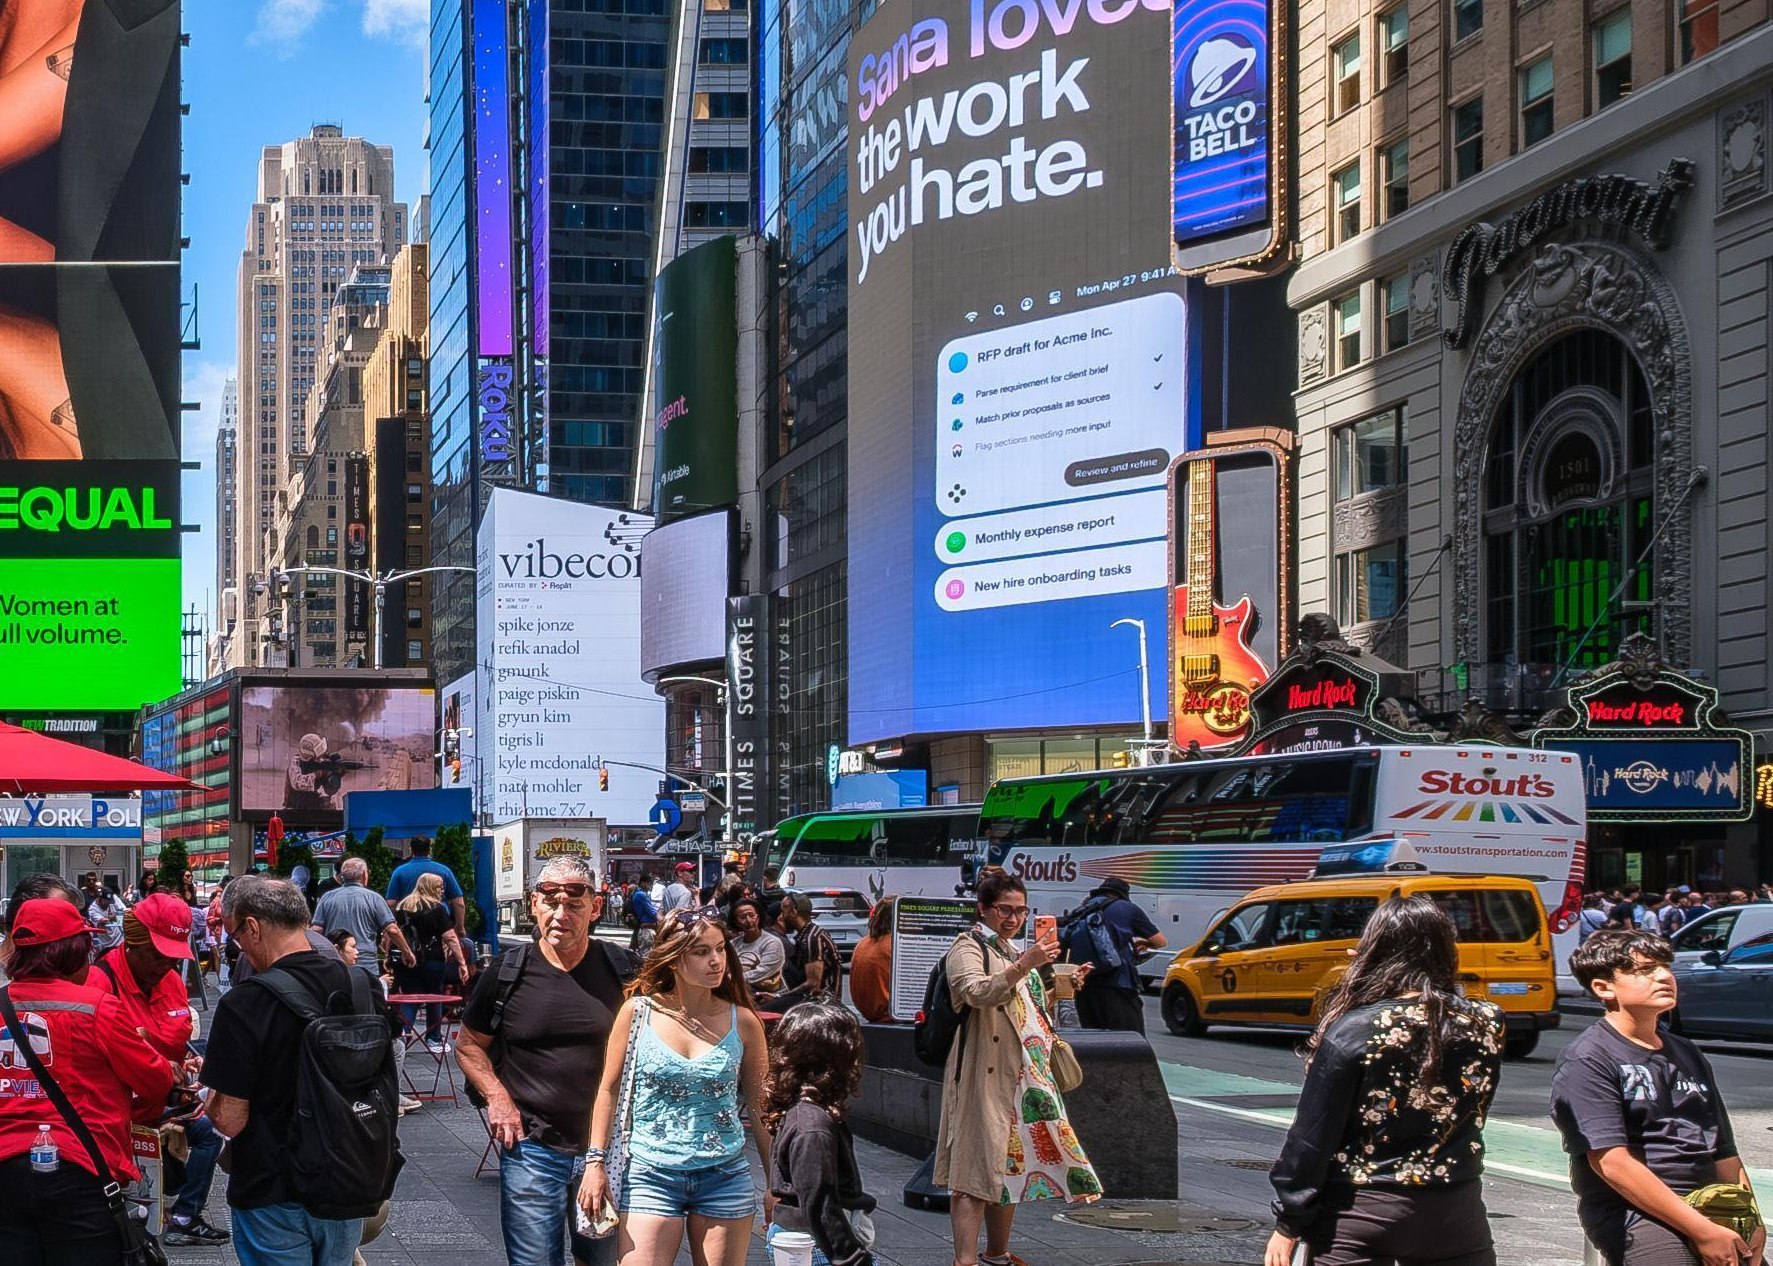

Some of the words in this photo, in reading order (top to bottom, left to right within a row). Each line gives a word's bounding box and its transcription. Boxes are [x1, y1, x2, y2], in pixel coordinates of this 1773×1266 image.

[857, 15, 948, 122] Sana
[857, 117, 901, 195] the
[905, 49, 1090, 153] work
[1184, 100, 1256, 141] TACO
[1189, 127, 1256, 163] BELL
[857, 183, 906, 285] you
[911, 138, 1103, 225] hate.
[1076, 284, 1100, 298] Mon
[1102, 279, 1121, 294] Apr
[1123, 275, 1137, 288] 27
[1141, 268, 1165, 283] 9:41
[977, 349, 1001, 364] RFP
[1003, 342, 1031, 358] draft
[1034, 338, 1051, 351] for
[1052, 333, 1088, 348] Acme
[1091, 326, 1113, 340] Inc.
[975, 386, 999, 399] Parse
[1000, 376, 1049, 395] requirement
[1050, 374, 1063, 385] for
[1064, 368, 1087, 382] client
[1089, 363, 1109, 377] brief
[975, 413, 1000, 426] Match
[1001, 410, 1020, 424] prior
[1022, 401, 1063, 419] proposals
[1065, 401, 1075, 409] as
[1077, 393, 1111, 407] sources
[975, 441, 992, 454] Flag
[994, 435, 1028, 450] sections
[1029, 429, 1064, 445] needing
[1065, 426, 1088, 437] more
[1089, 420, 1111, 435] input
[1075, 466, 1108, 479] Review
[1110, 463, 1128, 474] and
[1131, 457, 1158, 470] refine
[975, 529, 1021, 546] Monthly
[1024, 523, 1074, 541] expense
[1077, 515, 1115, 534] report
[497, 582, 527, 590] CURATED
[529, 582, 537, 590] BY
[549, 581, 572, 591] Replit
[974, 580, 1000, 593] New
[1003, 576, 1025, 589] hire
[1028, 568, 1096, 587] onboarding
[1099, 563, 1132, 577] tasks
[93, 596, 120, 616] at
[25, 622, 128, 645] volume.
[498, 618, 534, 637] spike
[536, 618, 574, 636] jonze
[498, 640, 530, 655] refik
[532, 640, 580, 655] anadol
[498, 663, 550, 678] gmunk
[738, 616, 754, 715] SQUARE
[498, 686, 535, 705] paige
[538, 685, 580, 705] piskin
[1181, 691, 1224, 712] Hard
[1289, 682, 1322, 710] Hard
[1323, 676, 1355, 708] Rock
[498, 712, 540, 728] gryun
[543, 710, 572, 723] kim
[1589, 702, 1636, 722] Hard
[1638, 702, 1684, 725] Rock
[498, 733, 533, 750] tigris
[535, 733, 544, 747] li
[498, 755, 527, 773] kyle
[529, 754, 602, 770] mcdonald
[1528, 754, 1548, 763] 312
[498, 780, 528, 793] nate
[532, 778, 582, 793] mohler
[738, 741, 753, 815] TIMES
[1418, 770, 1556, 798] Stout's
[1614, 768, 1641, 781] Hard
[1642, 767, 1669, 782] Rock
[26, 800, 84, 828] YORK
[498, 801, 557, 816] rhizome
[559, 803, 586, 816] 7x7
[534, 839, 592, 858] RIVIERA
[666, 841, 724, 853] CHASE
[1012, 852, 1077, 883] Stout's
[132, 1141, 156, 1152] ass
